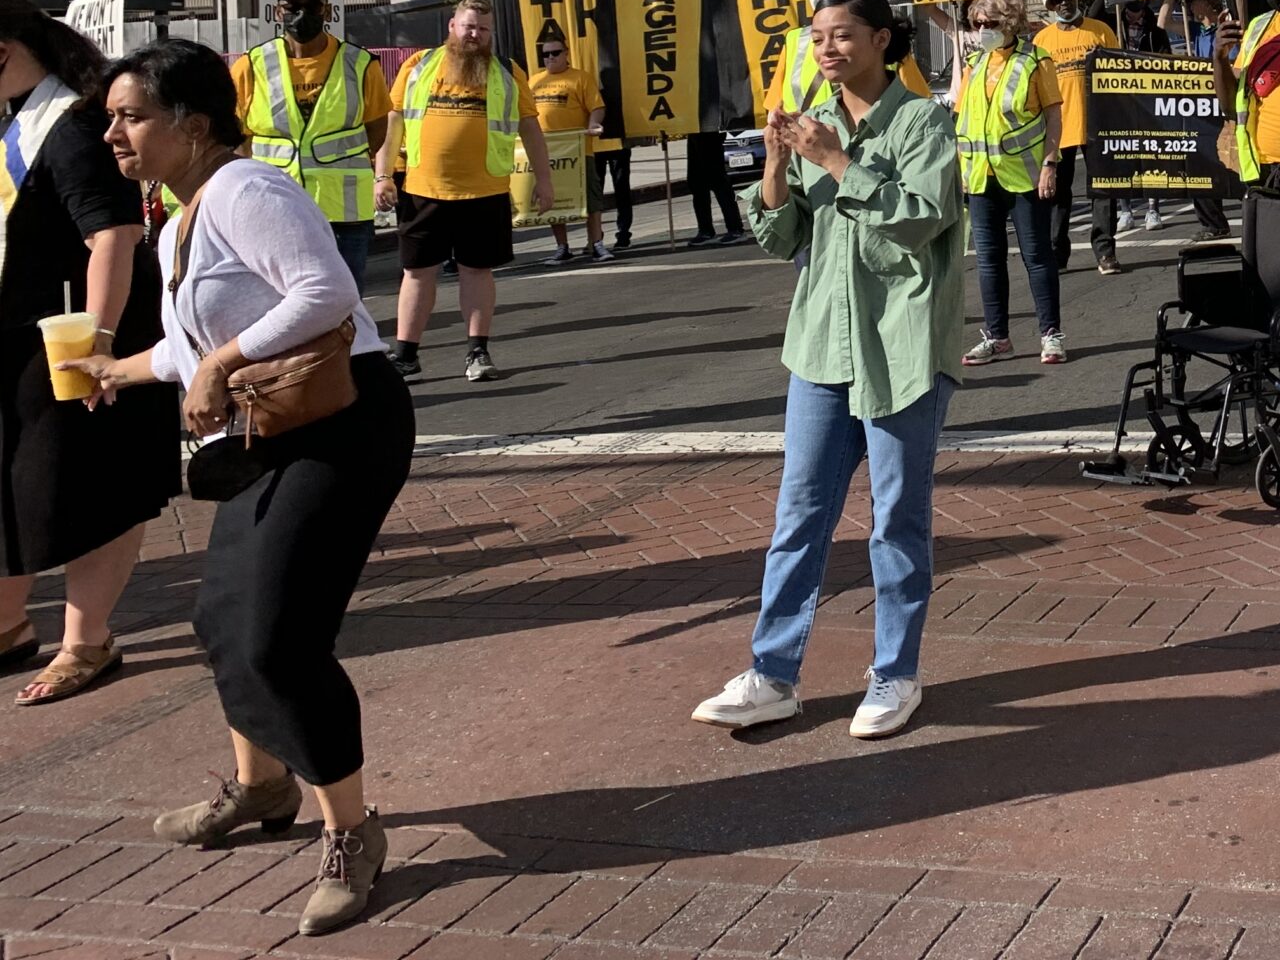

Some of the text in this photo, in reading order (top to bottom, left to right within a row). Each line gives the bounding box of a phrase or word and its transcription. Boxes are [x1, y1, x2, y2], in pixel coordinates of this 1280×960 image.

[1095, 58, 1133, 70] MASS
[1135, 59, 1171, 71] POOR
[1173, 60, 1215, 72] PEOPL
[1097, 78, 1216, 90] MORAL MARCH O
[1154, 97, 1226, 117] MOBI
[1102, 139, 1197, 155] JUNE 18, 2022
[511, 157, 578, 175] LIRITY
